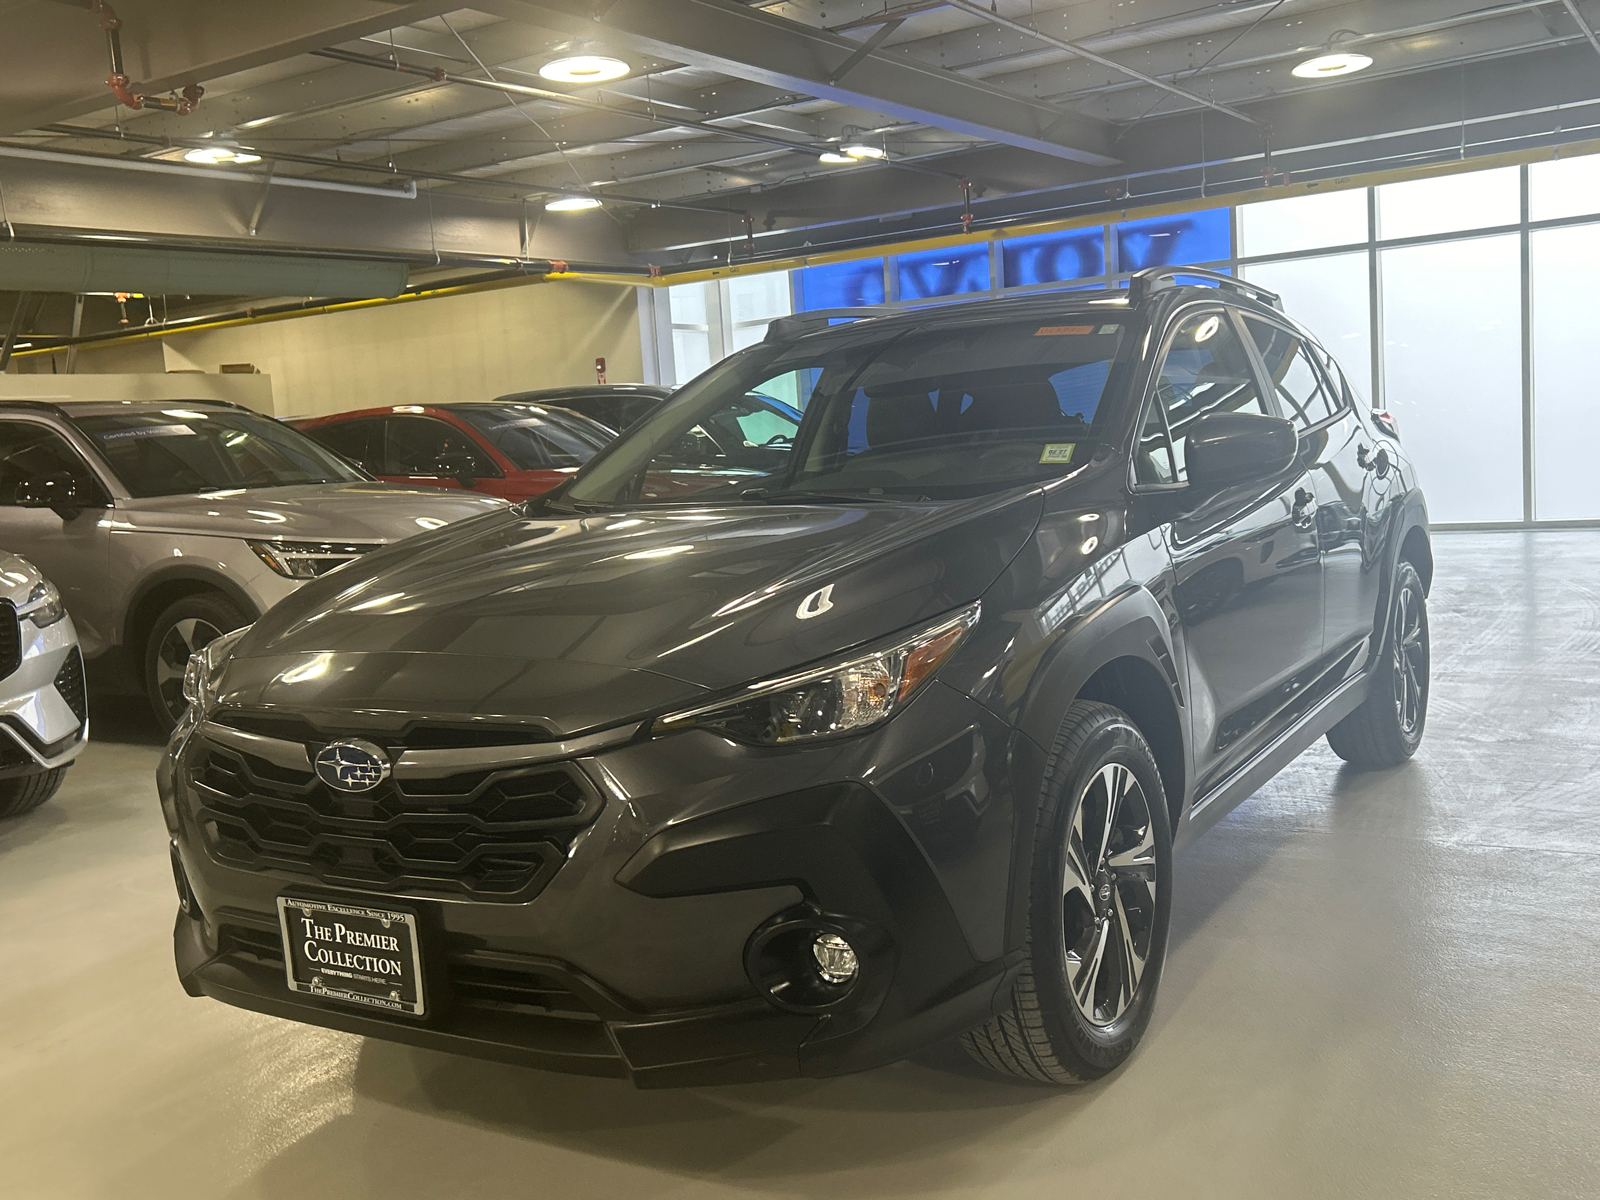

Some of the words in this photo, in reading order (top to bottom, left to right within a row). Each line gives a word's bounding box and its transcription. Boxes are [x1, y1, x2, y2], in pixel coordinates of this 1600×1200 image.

[287, 899, 327, 911] AUTOMOTIVE
[327, 904, 365, 916] EXCELLENCE
[366, 910, 385, 919] SINCE
[386, 912, 405, 922] 1995
[301, 917, 333, 942] THE
[333, 922, 400, 952] PREMIER
[303, 940, 402, 976] COLLECTION
